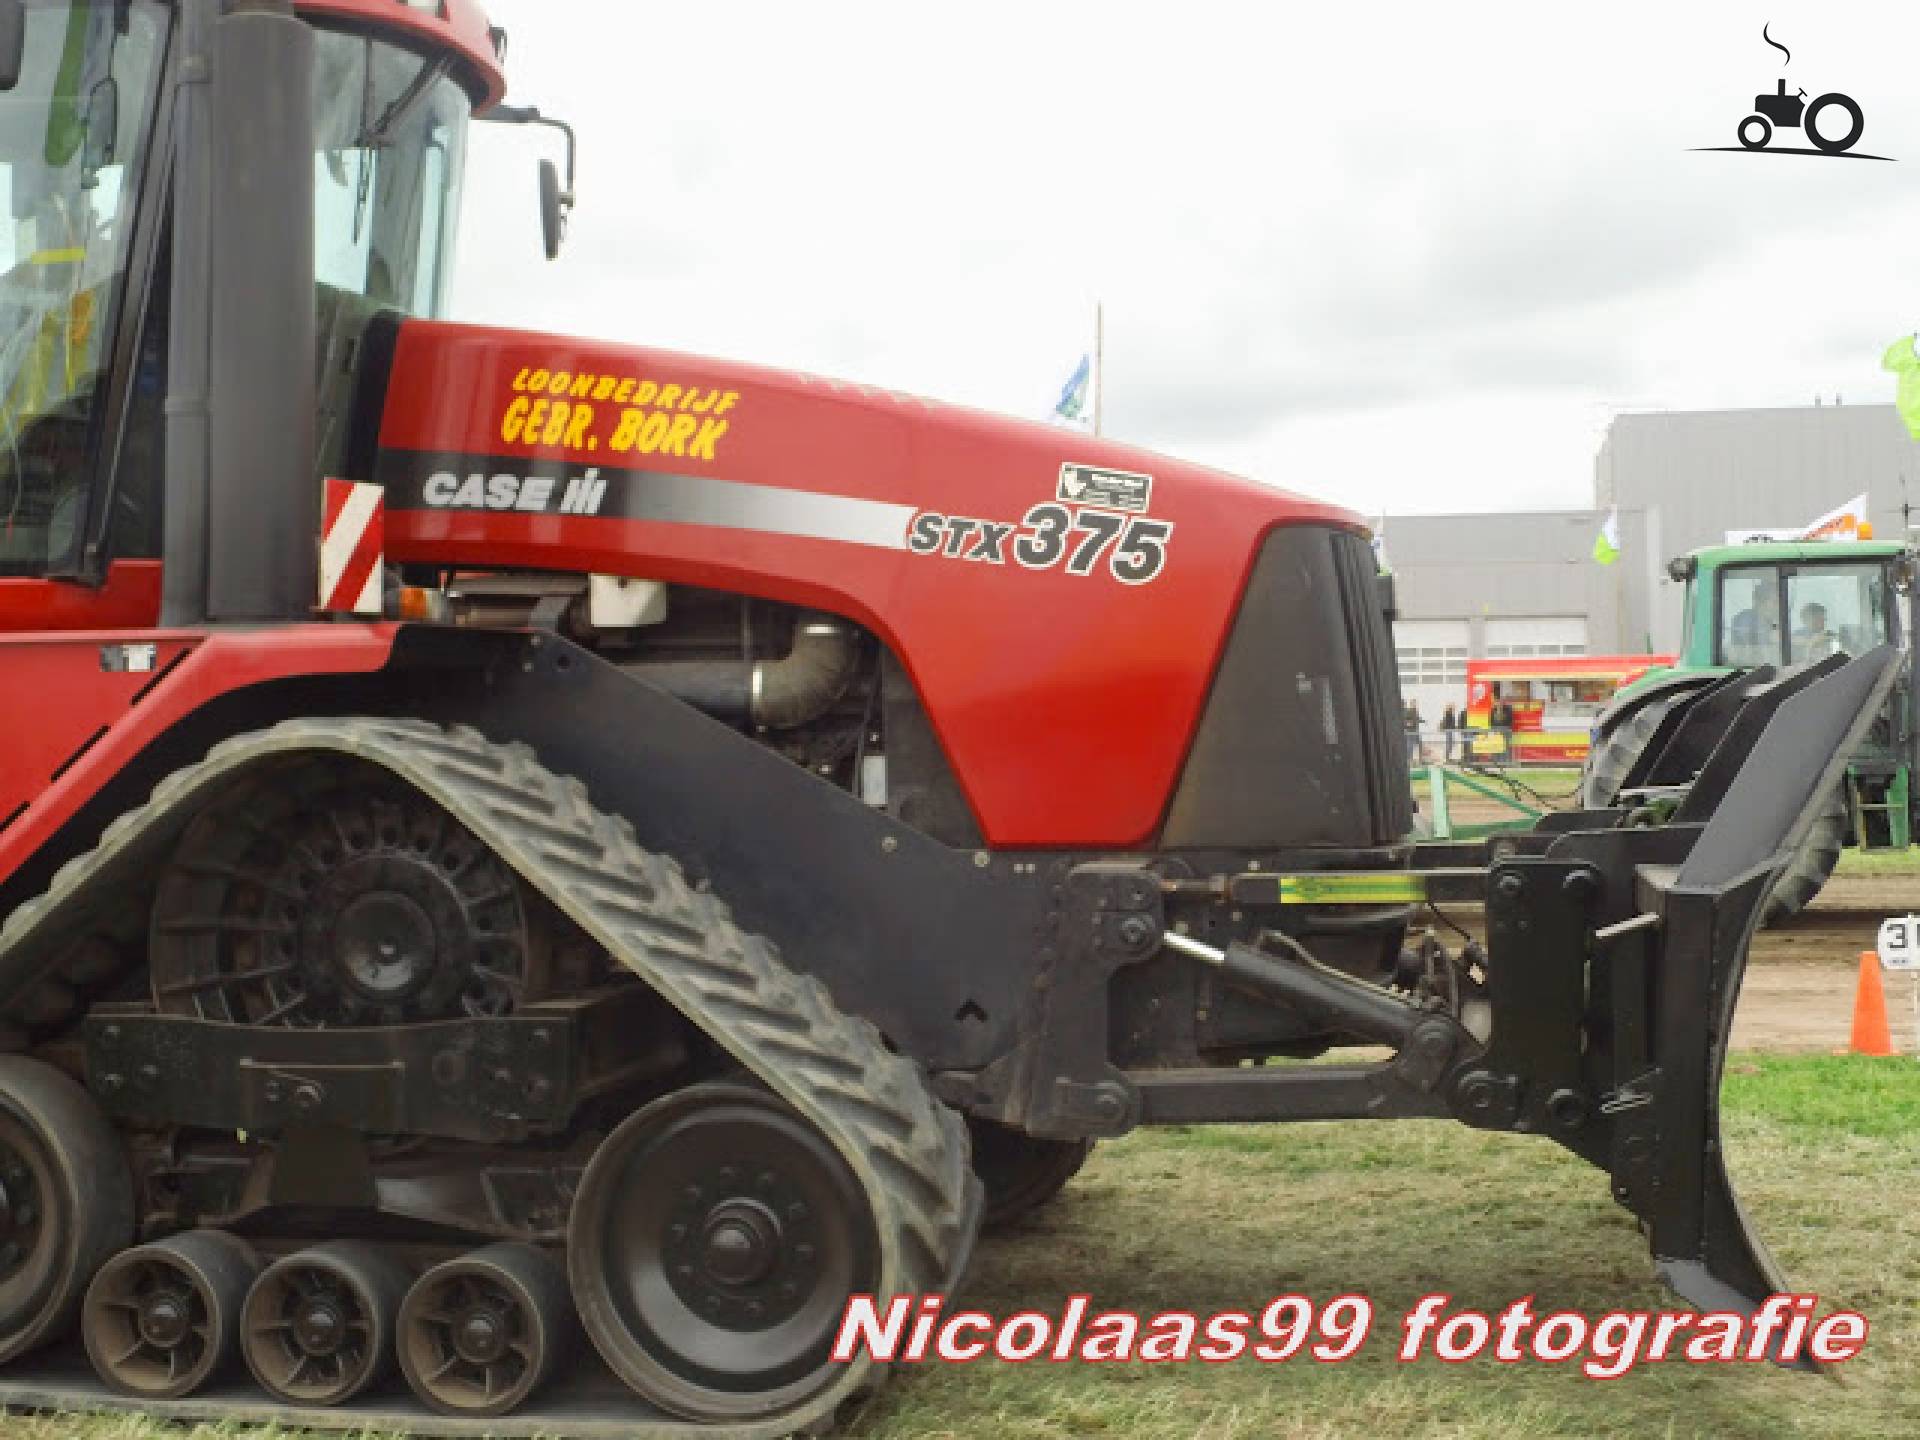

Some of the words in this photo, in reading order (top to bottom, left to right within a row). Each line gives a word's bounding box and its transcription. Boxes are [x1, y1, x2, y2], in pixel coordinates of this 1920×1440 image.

[512, 367, 740, 414] LOONBEDRIJF
[502, 396, 597, 450] GEBR.
[609, 409, 728, 460] BORK
[422, 471, 555, 511] CASE
[910, 512, 1016, 564] STX
[1014, 503, 1174, 585] 375
